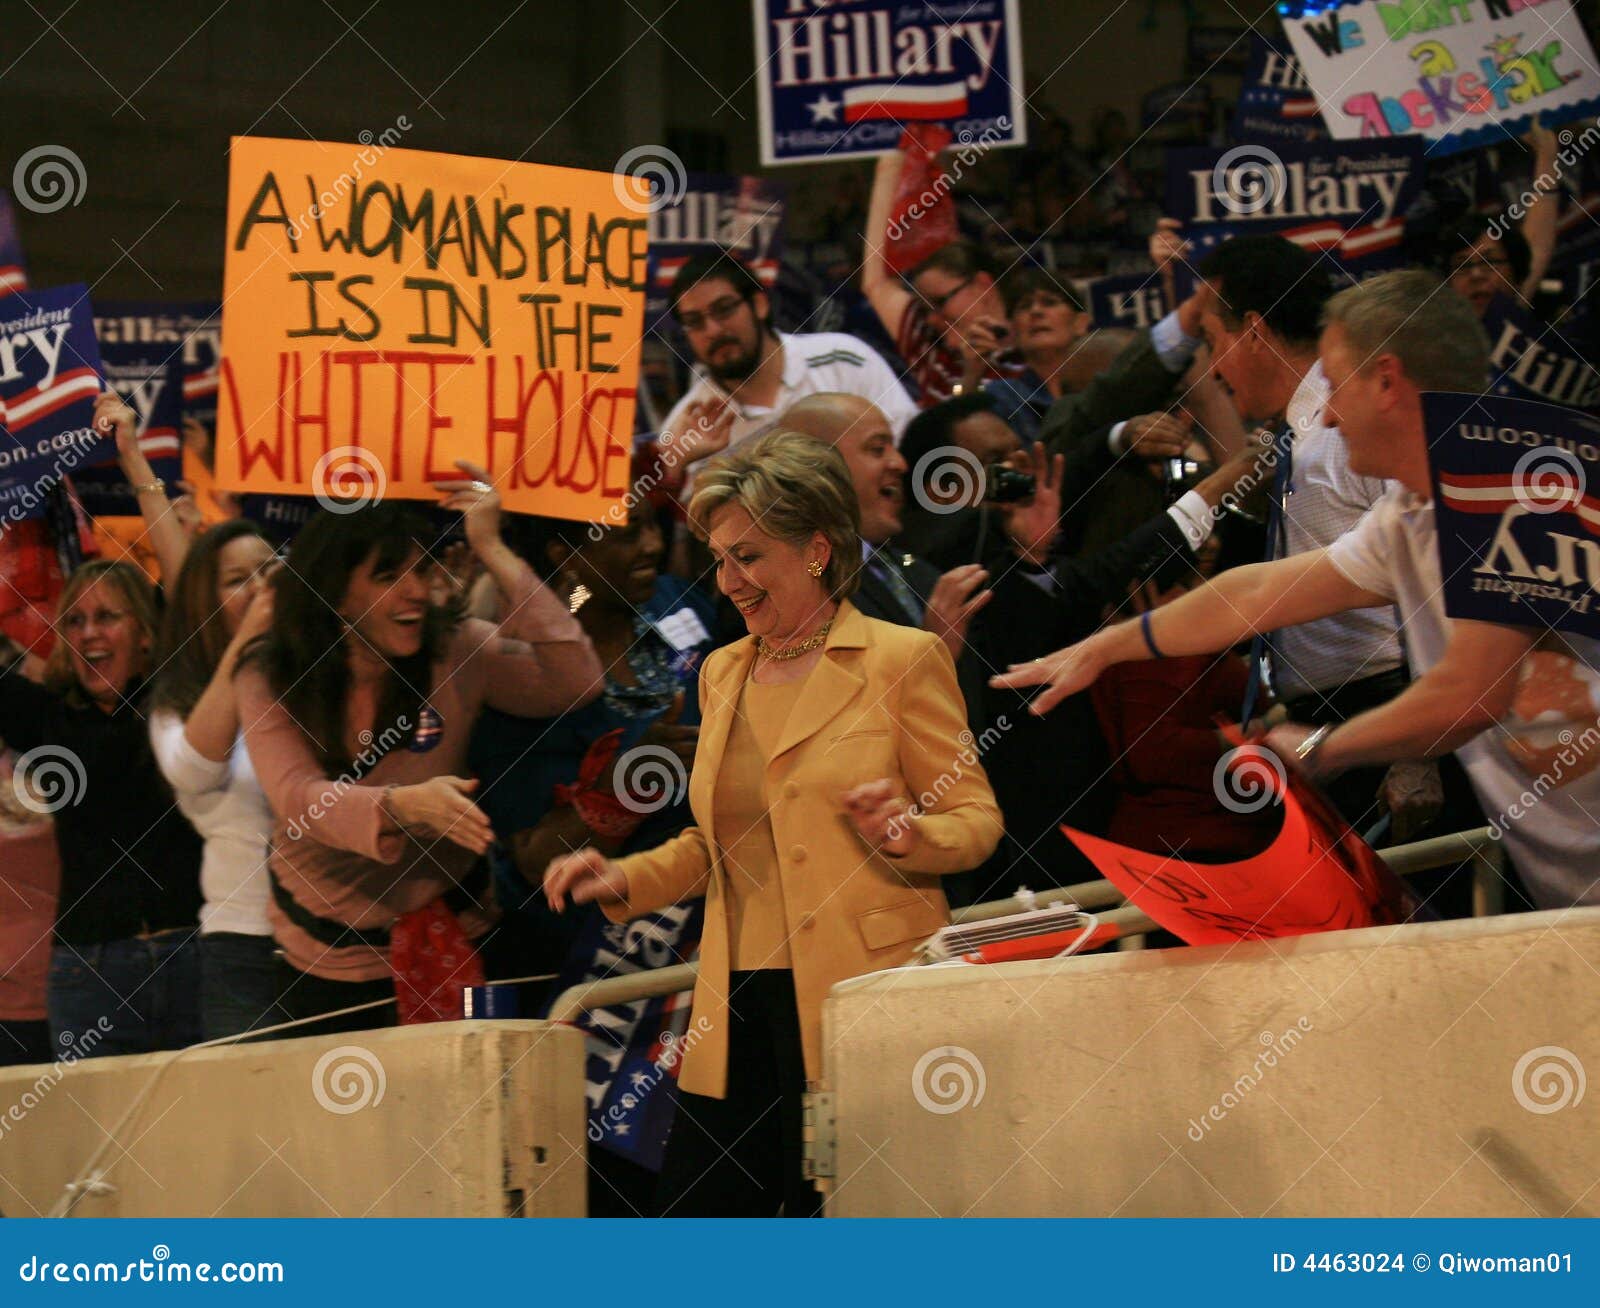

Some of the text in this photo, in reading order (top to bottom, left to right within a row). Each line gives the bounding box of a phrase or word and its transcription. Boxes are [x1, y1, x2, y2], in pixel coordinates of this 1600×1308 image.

[772, 10, 1002, 91] Hillary
[236, 171, 648, 292] A WOMAN'S PLACE
[1189, 162, 1410, 229] Hillary
[287, 271, 623, 373] IS IN THE
[222, 350, 636, 499] WHITE HOUSE
